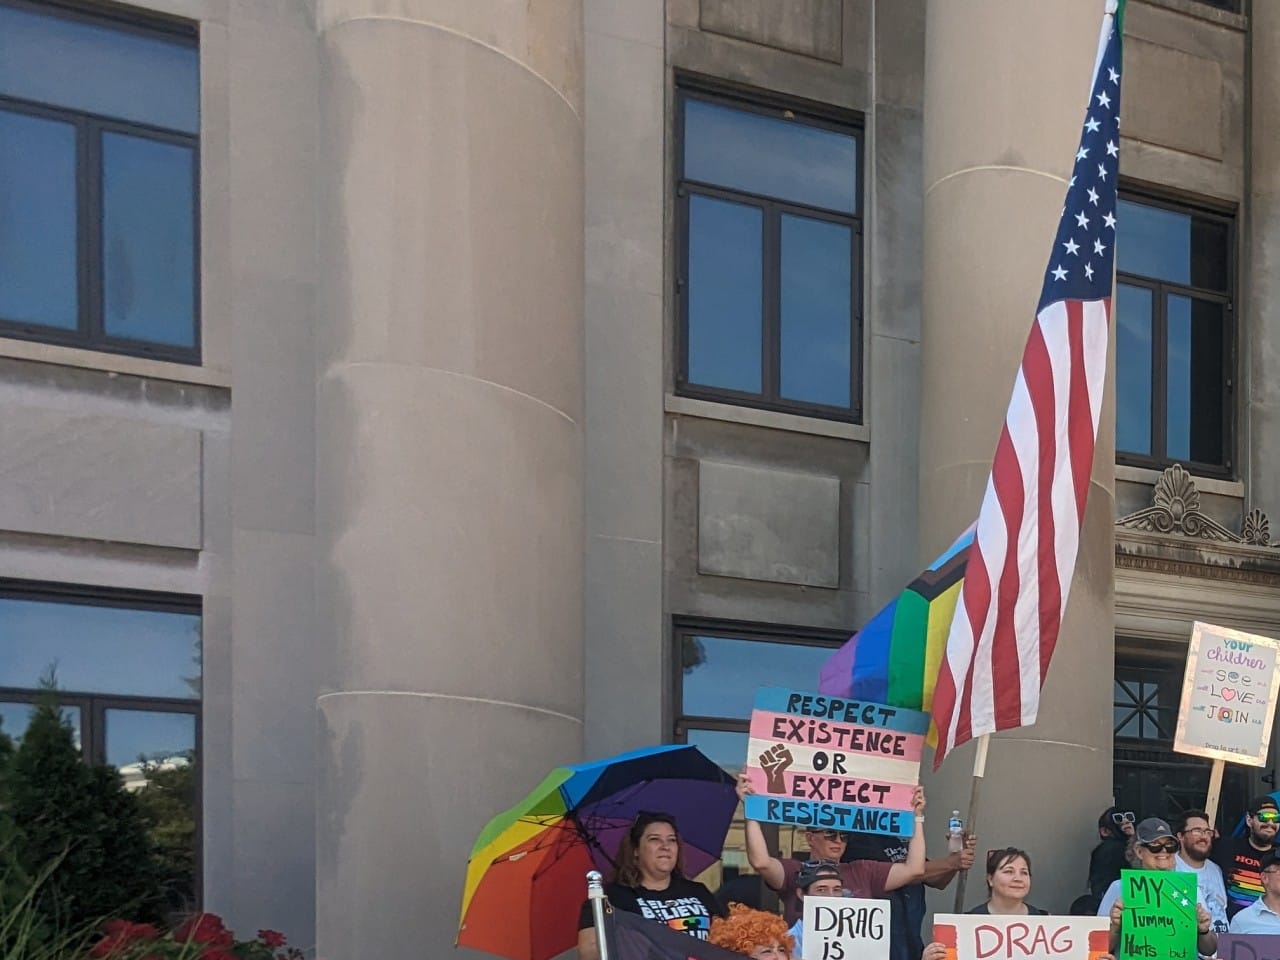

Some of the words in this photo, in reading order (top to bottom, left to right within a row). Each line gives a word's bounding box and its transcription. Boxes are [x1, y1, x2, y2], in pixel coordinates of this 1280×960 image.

[1207, 647, 1266, 670] children
[787, 693, 896, 726] RESPECT
[812, 751, 847, 775] OR
[792, 775, 890, 804] EXPECT
[1235, 855, 1260, 867] HON
[1130, 875, 1164, 908] MY
[815, 906, 884, 940] DRAG
[1124, 907, 1176, 936] Tummy
[975, 923, 1073, 959] DRAG
[1169, 947, 1188, 959] but
